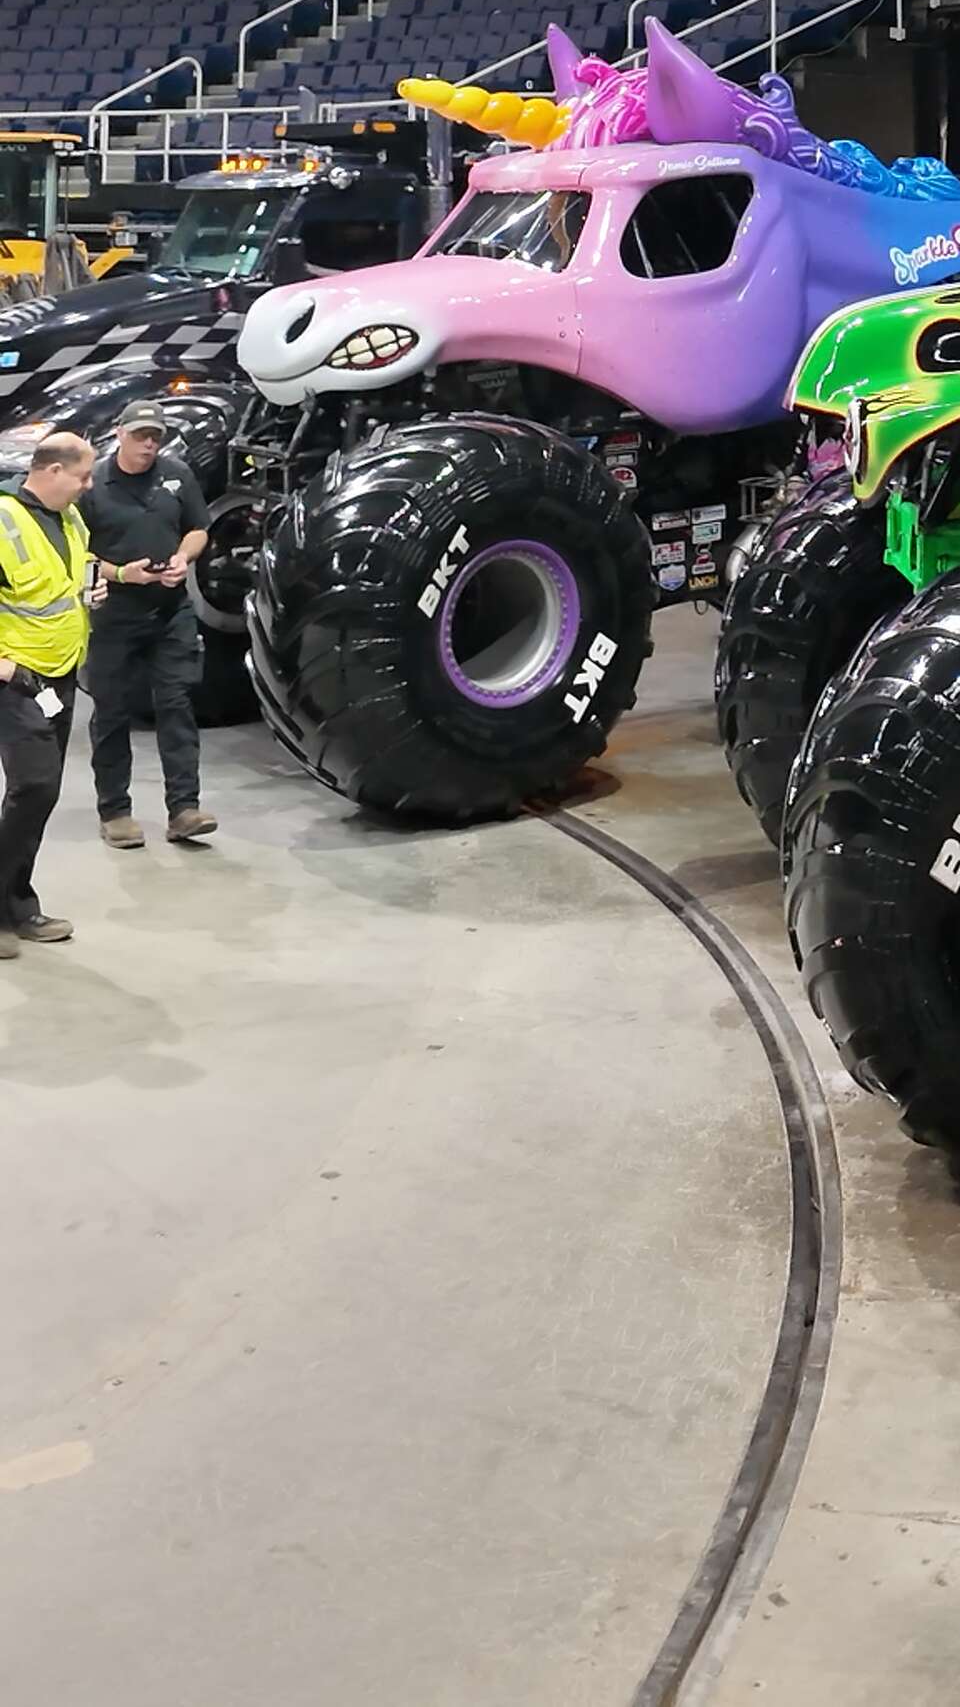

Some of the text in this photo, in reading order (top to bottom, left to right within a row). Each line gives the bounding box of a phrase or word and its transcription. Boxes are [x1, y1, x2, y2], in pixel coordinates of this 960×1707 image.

[890, 236, 958, 284] Sparkle
[417, 524, 470, 618] BKT
[564, 632, 618, 724] BKT
